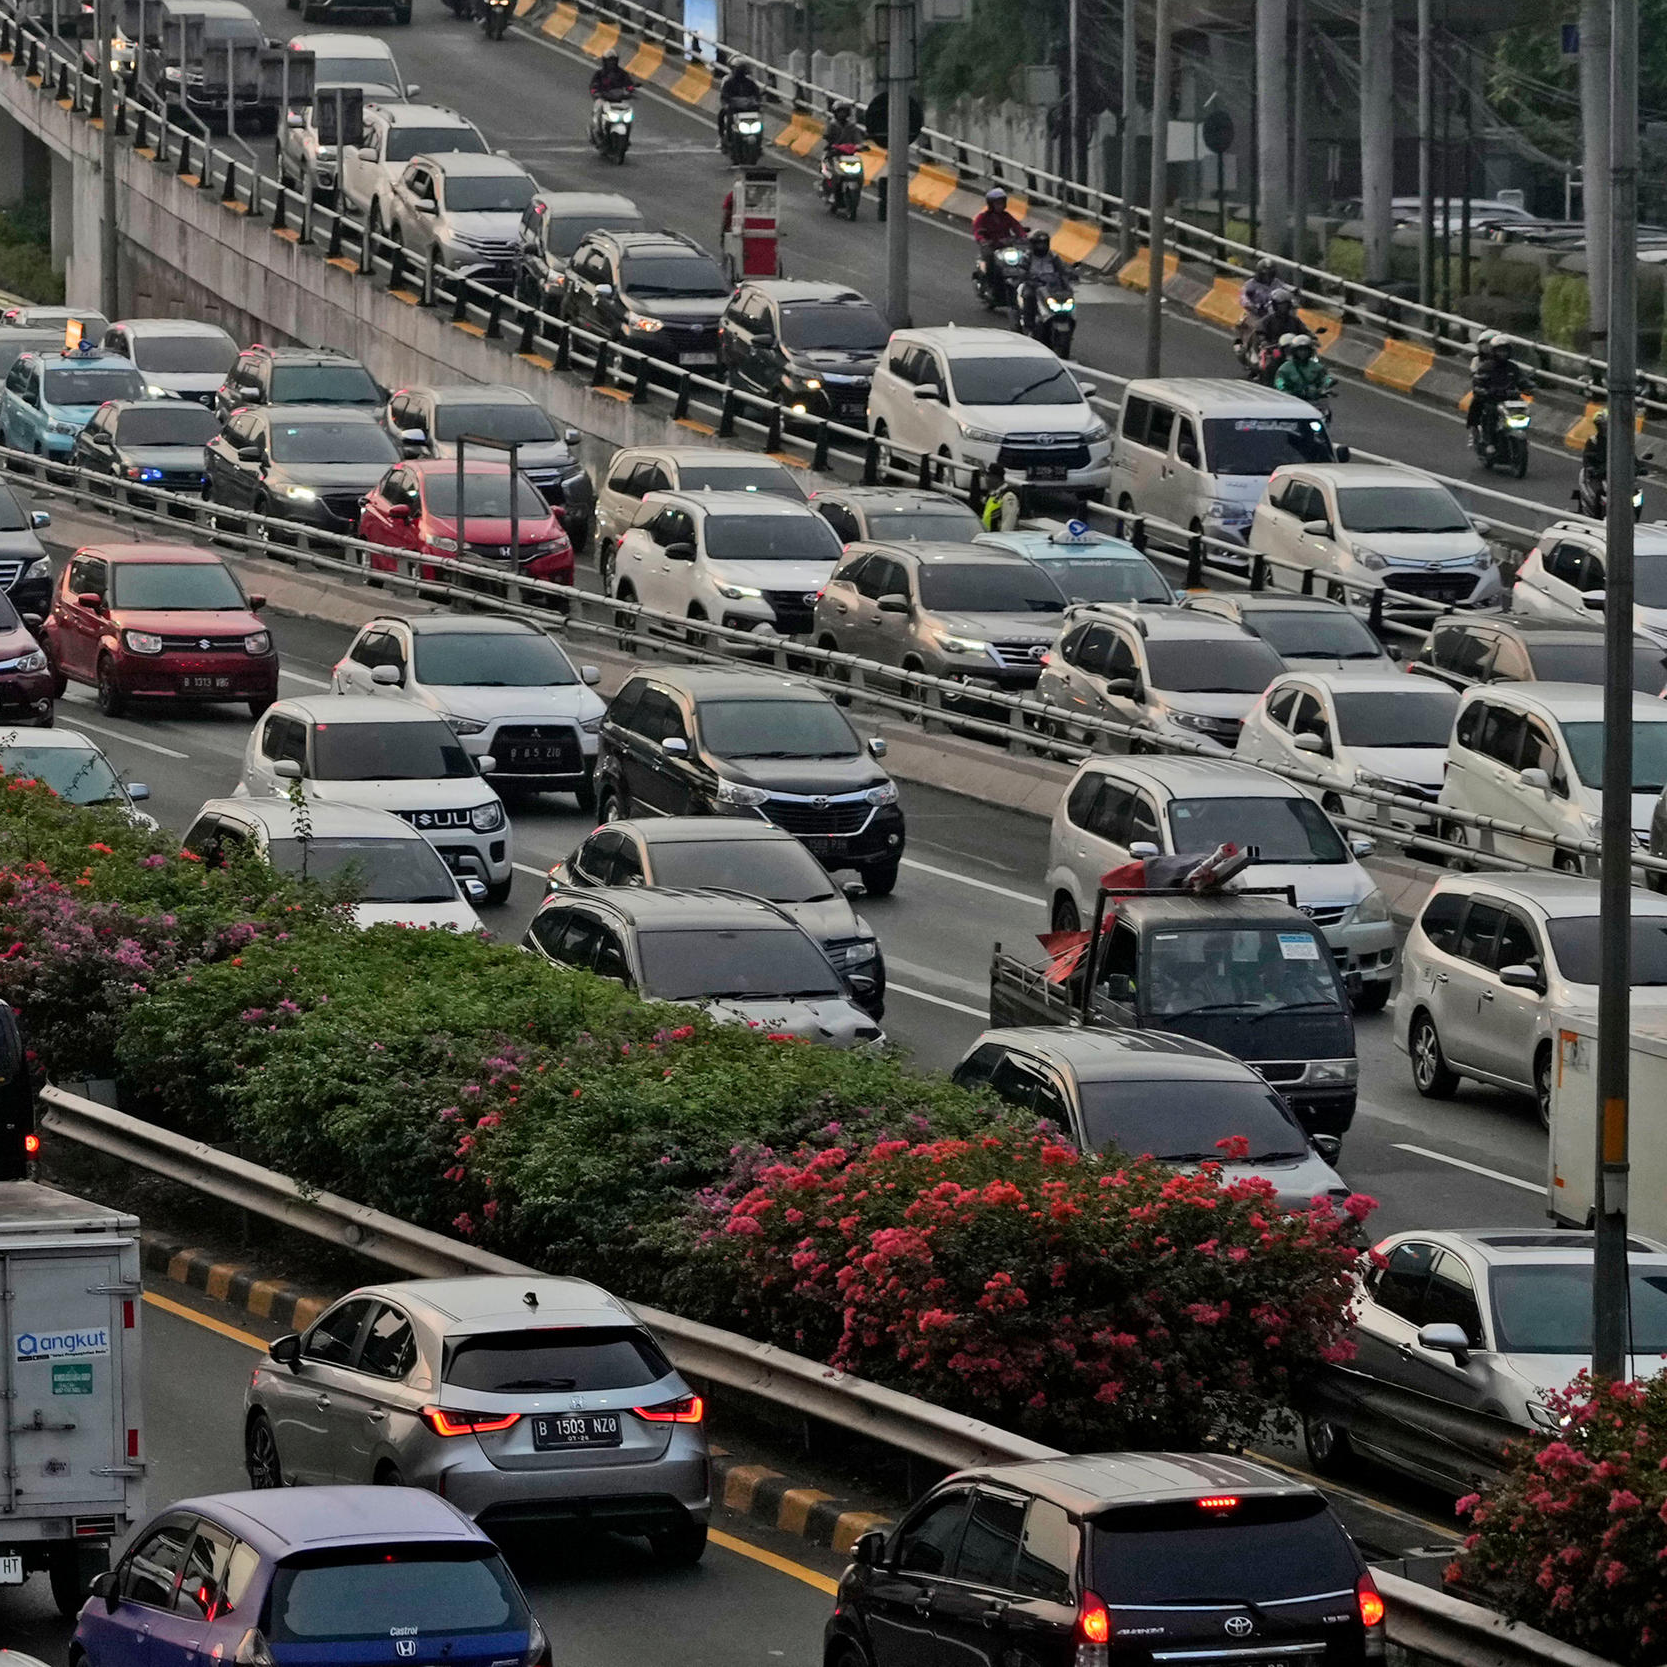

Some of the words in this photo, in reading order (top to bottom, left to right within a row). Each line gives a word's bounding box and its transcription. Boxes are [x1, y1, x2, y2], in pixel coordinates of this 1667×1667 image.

[41, 1330, 107, 1351] angkut
[539, 1422, 547, 1435] B
[556, 1420, 586, 1434] 1503
[3, 1558, 18, 1572] HT
[389, 1626, 418, 1636] Castrol
